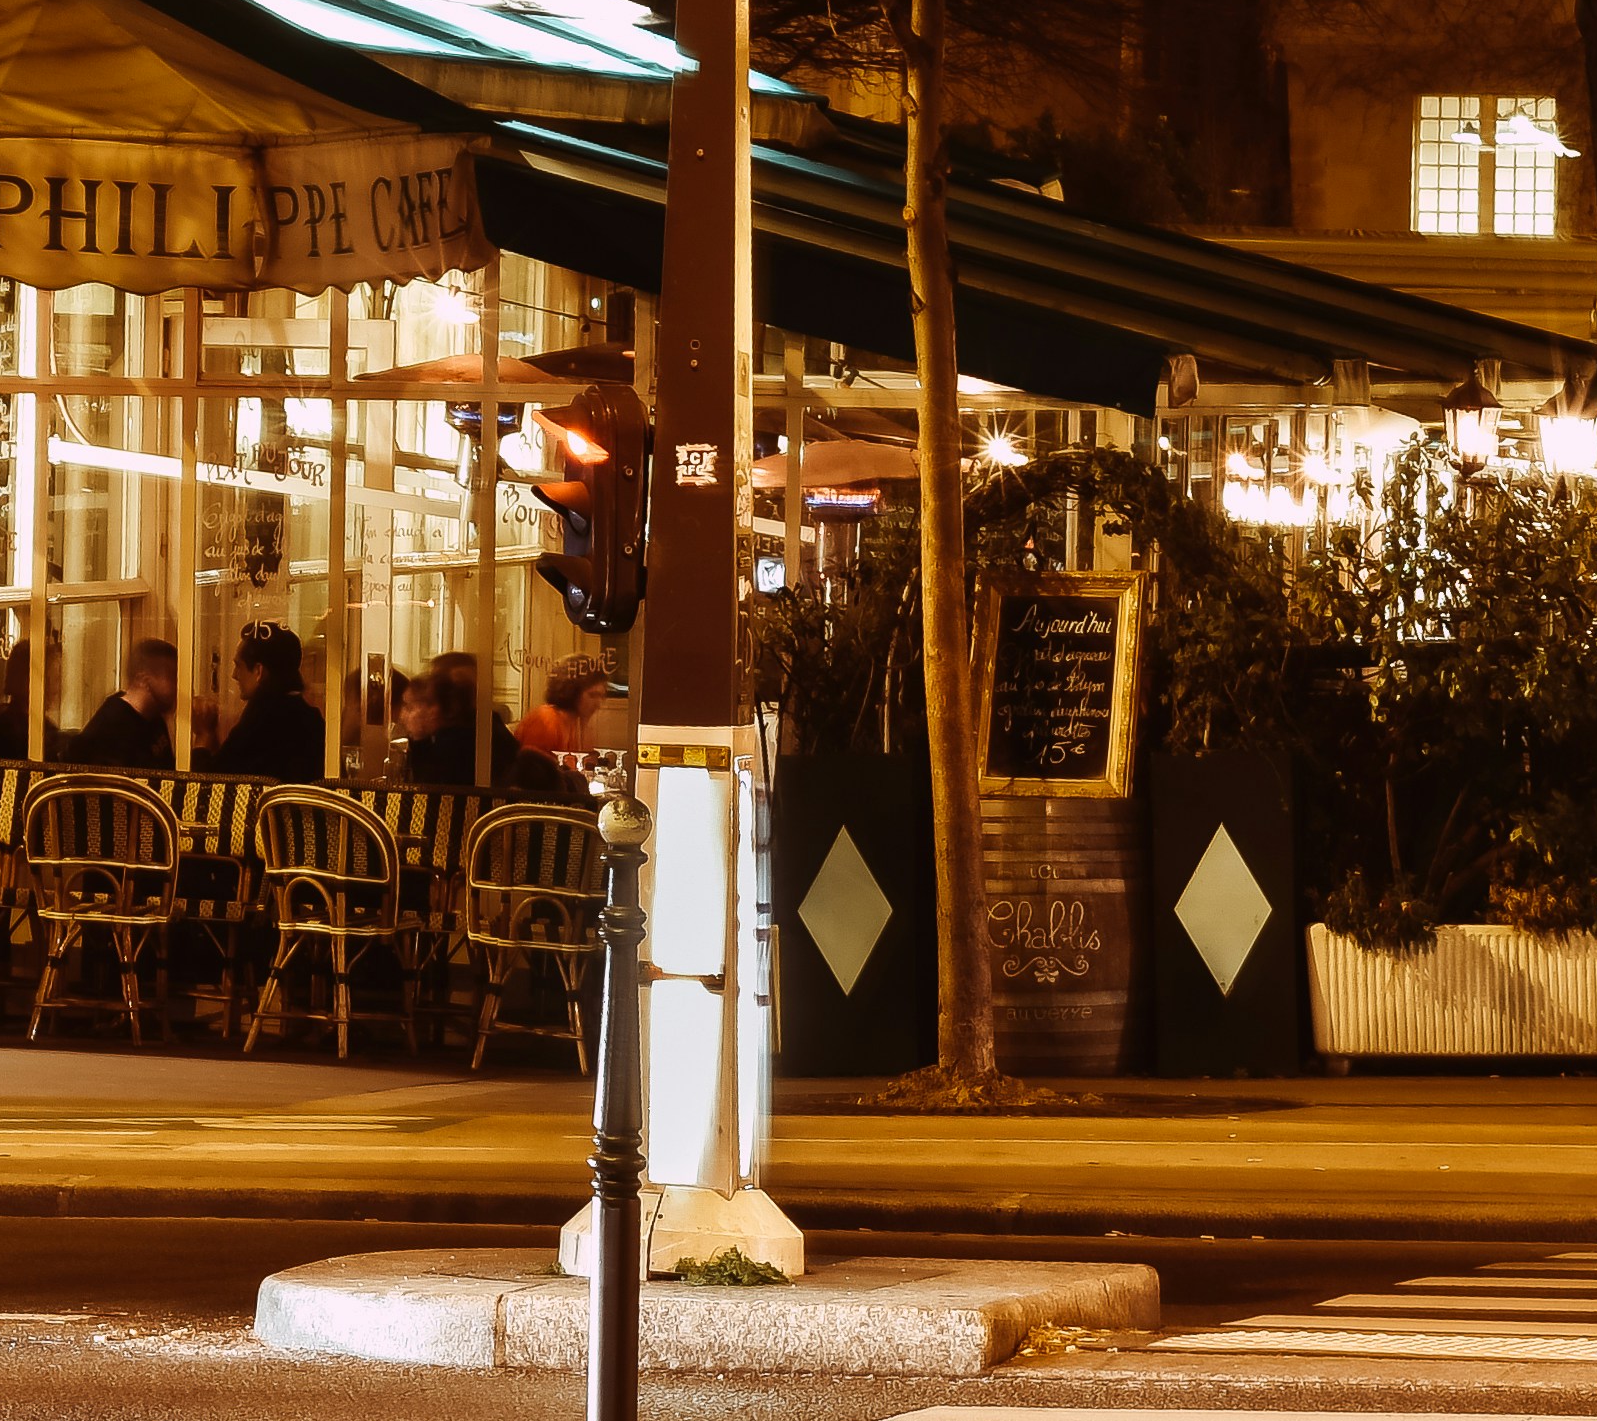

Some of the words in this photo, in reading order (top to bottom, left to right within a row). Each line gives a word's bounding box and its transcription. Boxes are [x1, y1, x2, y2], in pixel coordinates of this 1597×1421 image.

[274, 449, 326, 488] JOUR
[1012, 603, 1113, 639] Aujourd'hui
[986, 900, 1101, 951] Chablis
